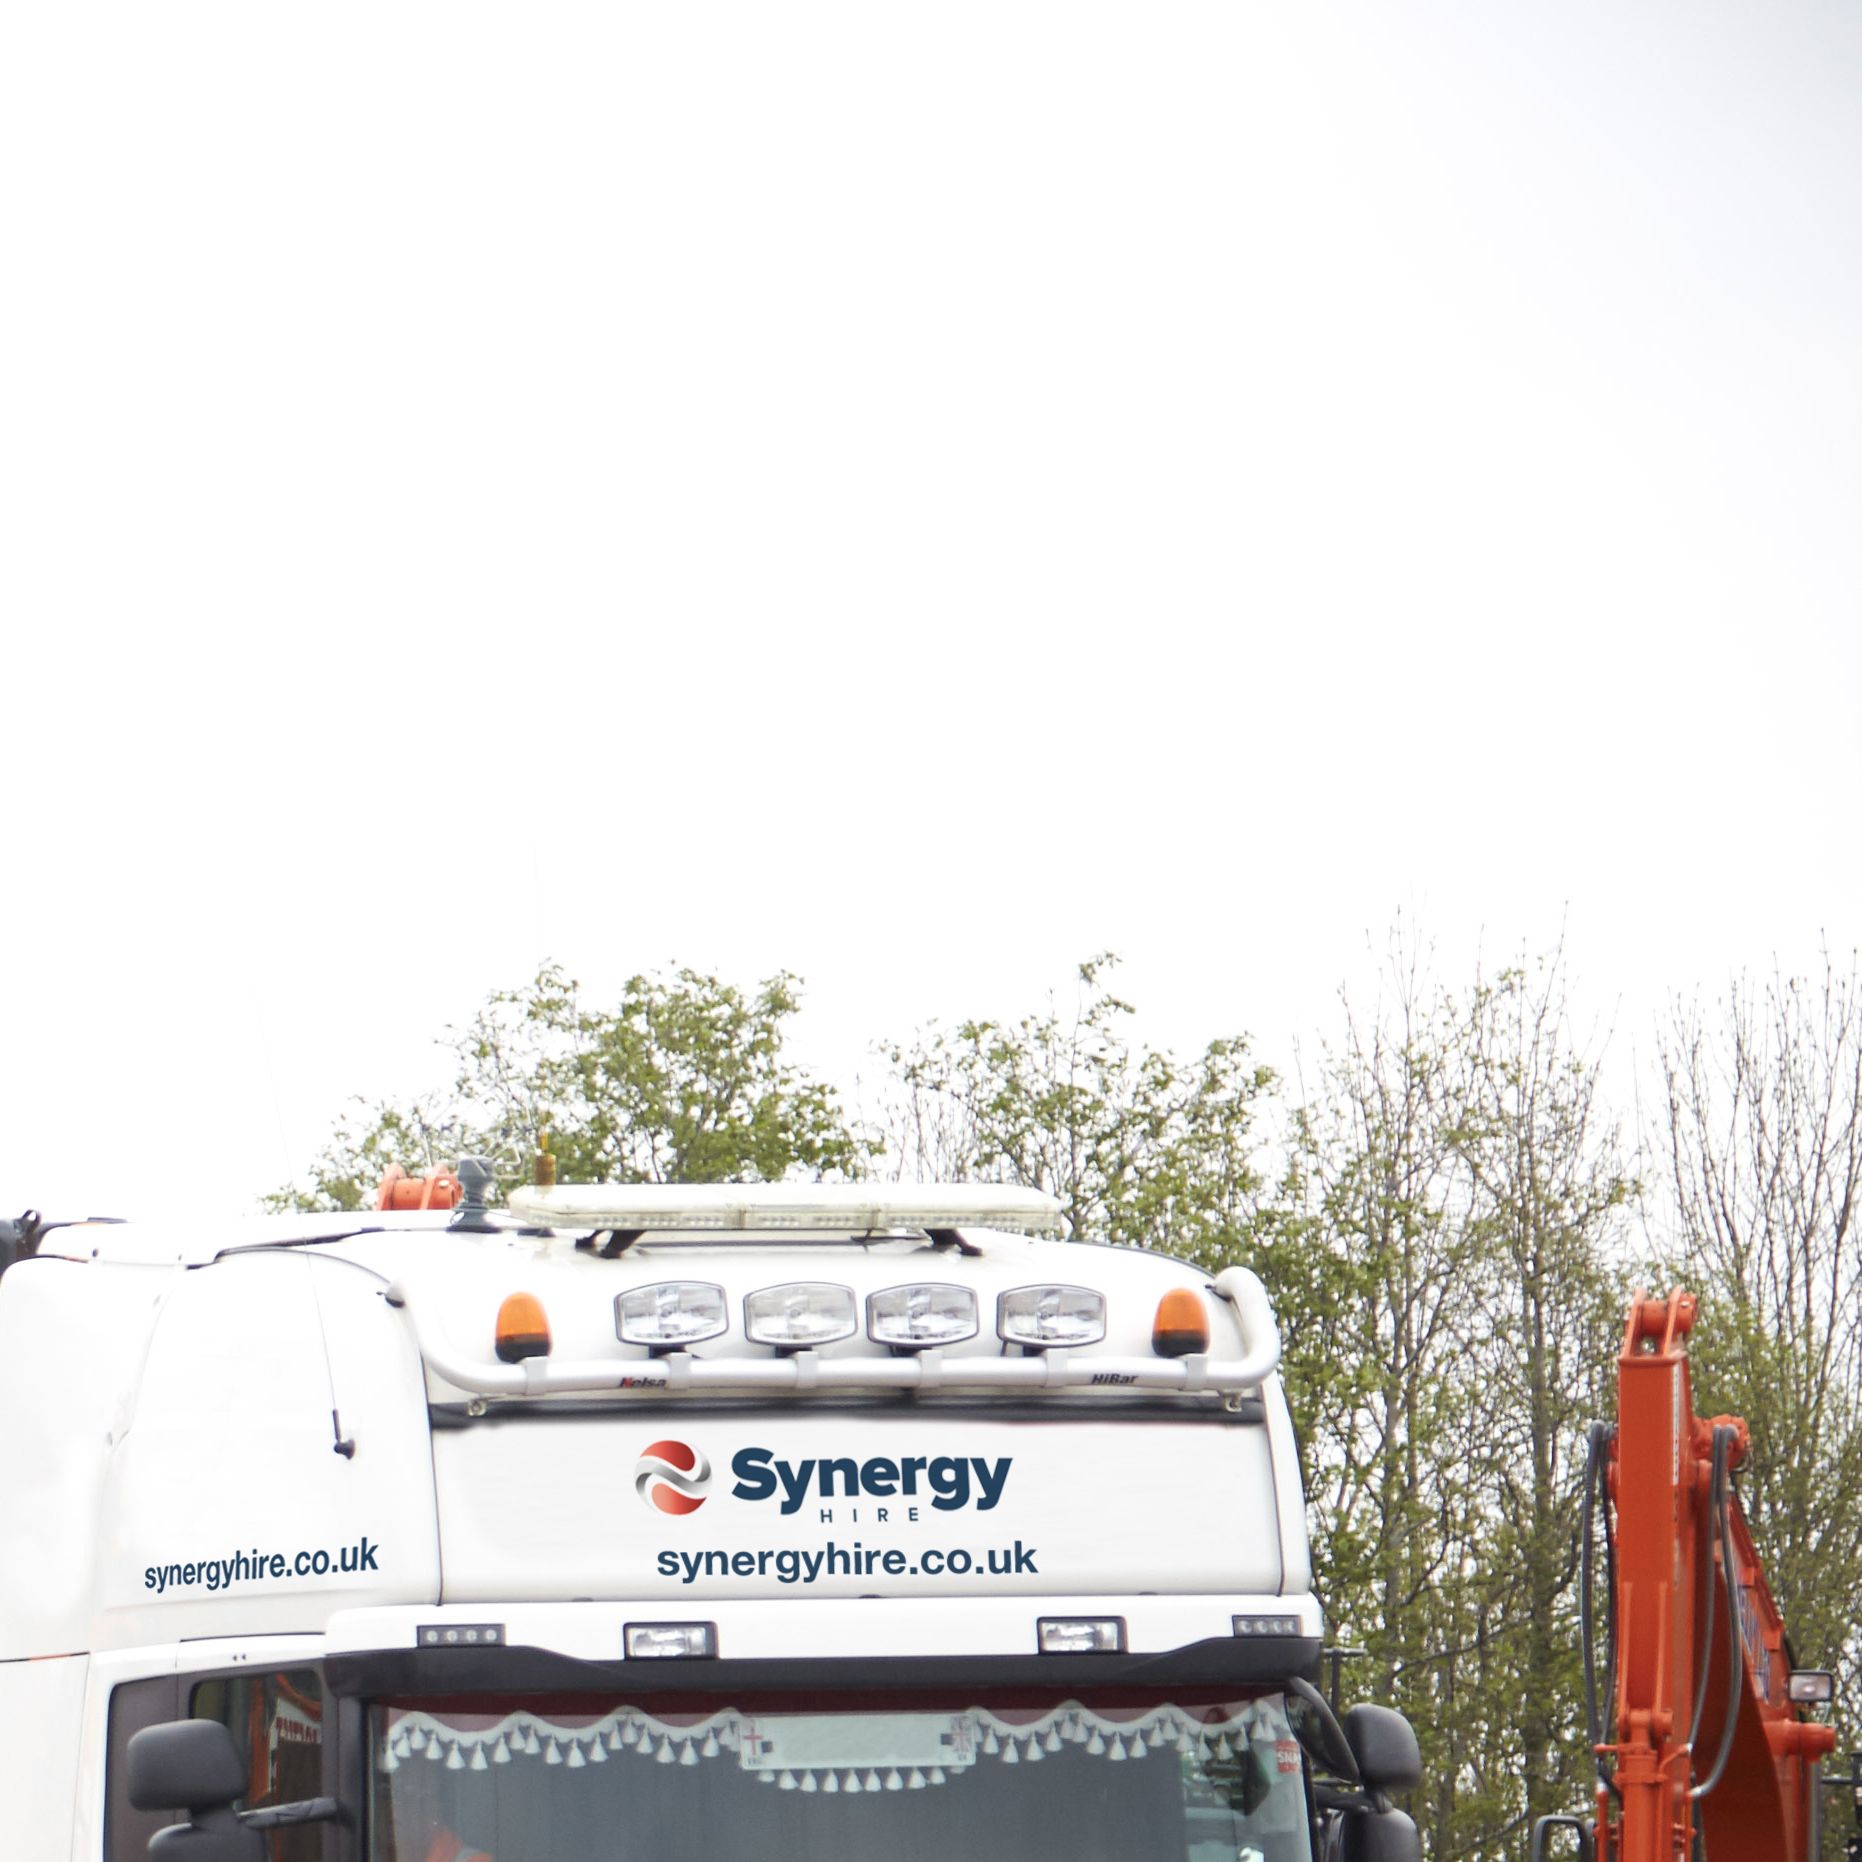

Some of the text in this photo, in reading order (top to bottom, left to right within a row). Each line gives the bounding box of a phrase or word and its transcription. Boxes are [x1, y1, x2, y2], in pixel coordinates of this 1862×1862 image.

[731, 1447, 1013, 1515] Synergy
[820, 1507, 919, 1523] HIRE
[145, 1537, 378, 1593] synergyhire.co.uk
[657, 1540, 1039, 1584] synergyhire.co.uk
